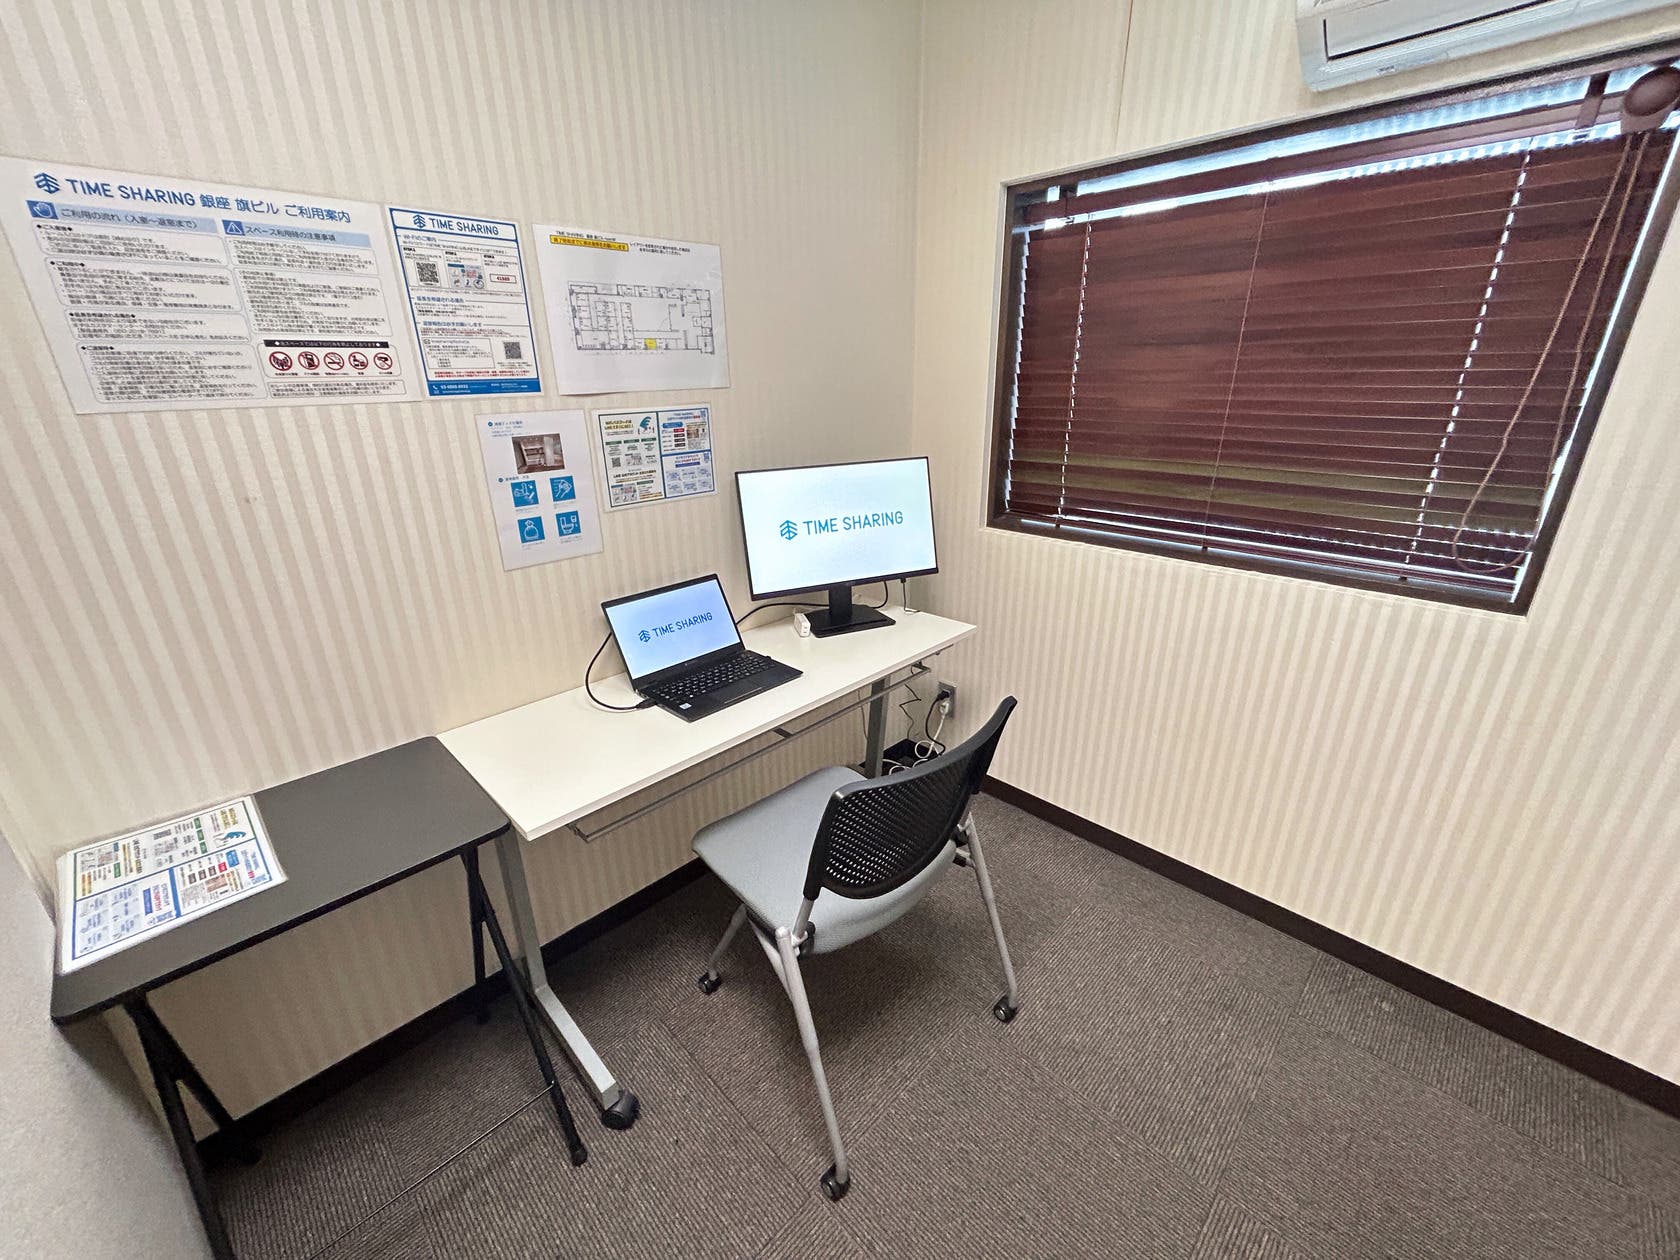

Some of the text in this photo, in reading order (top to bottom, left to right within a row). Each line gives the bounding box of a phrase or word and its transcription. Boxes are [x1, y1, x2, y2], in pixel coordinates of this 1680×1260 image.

[65, 178, 351, 223] TIME SHARING 銀座 旗ビル ご利用案内
[245, 225, 336, 242] スペース利用時の注意事項
[428, 217, 499, 235] TIME SHARING
[803, 510, 904, 535] TIME SHARING
[652, 611, 713, 638] TIME SHARING
